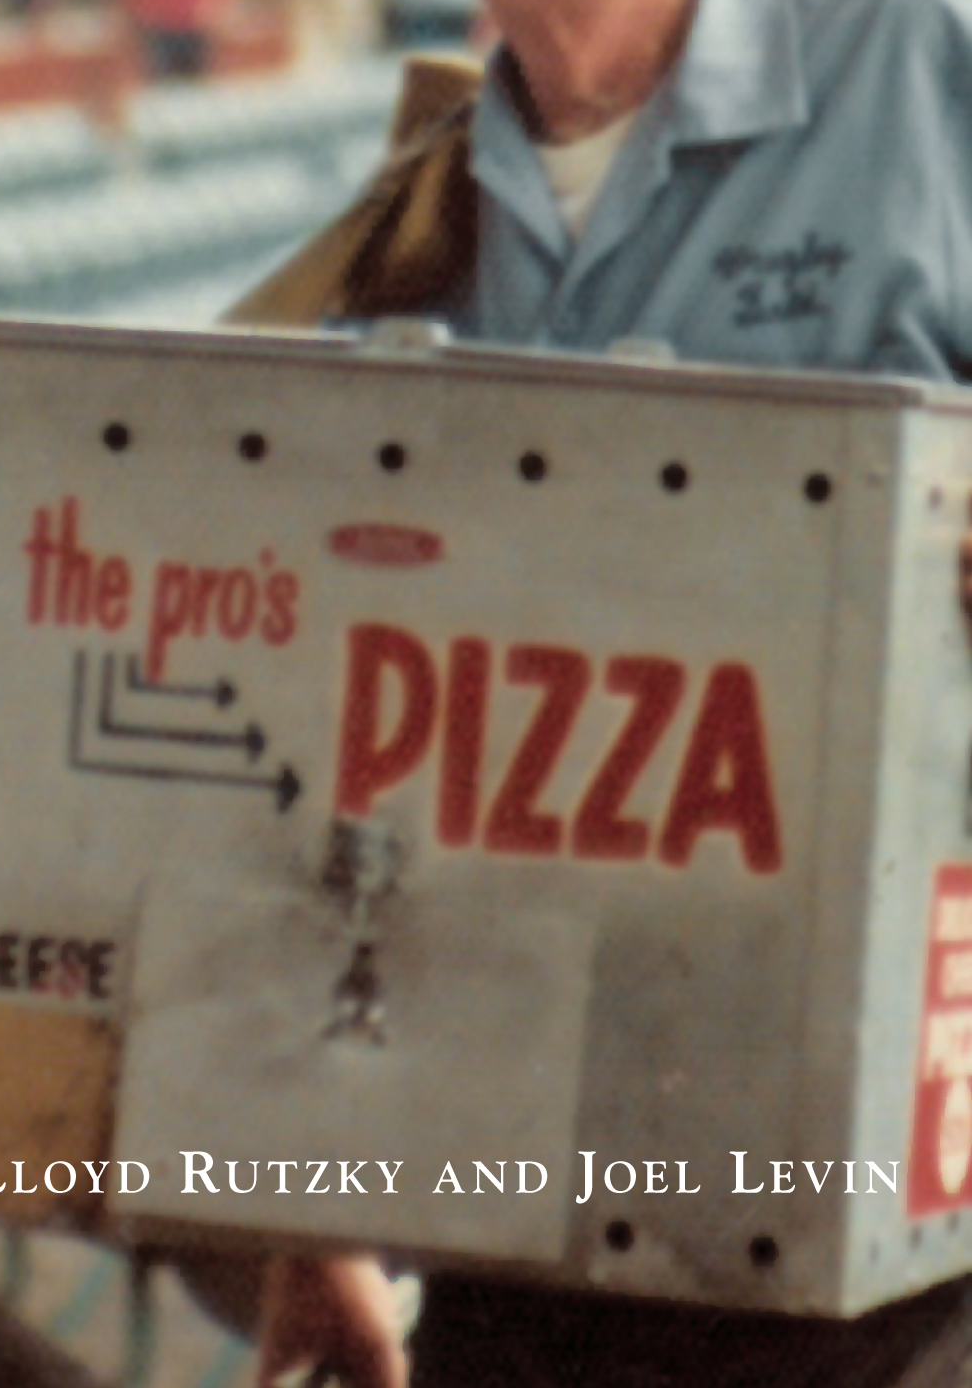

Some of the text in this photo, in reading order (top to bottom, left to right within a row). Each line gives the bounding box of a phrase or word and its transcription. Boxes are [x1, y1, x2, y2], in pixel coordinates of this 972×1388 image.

[22, 494, 300, 684] the pro's
[335, 622, 783, 875] PIZZA
